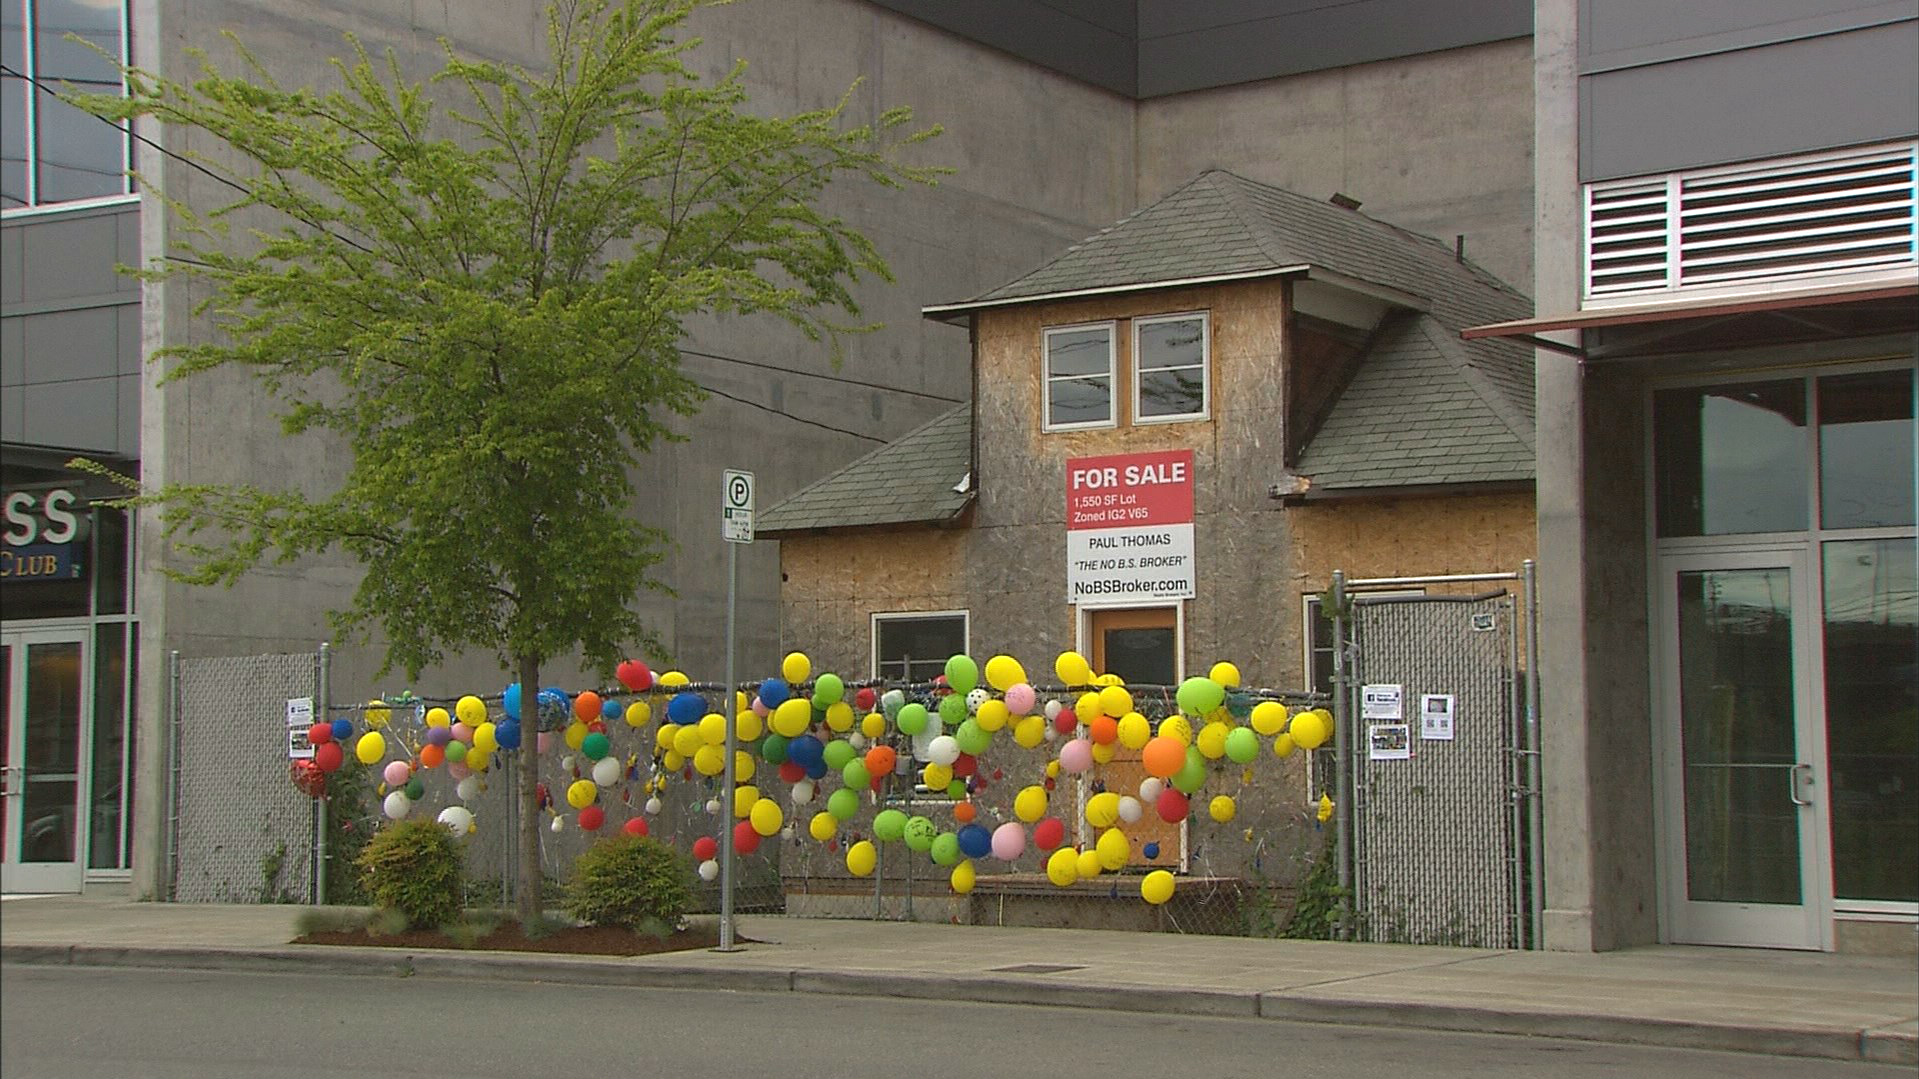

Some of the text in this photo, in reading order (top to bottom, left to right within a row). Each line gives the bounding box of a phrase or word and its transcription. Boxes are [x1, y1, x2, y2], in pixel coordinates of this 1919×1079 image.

[1073, 462, 1185, 490] FOR SALE
[735, 483, 745, 500] P
[1074, 494, 1136, 508] 1,550 SF Lot
[1074, 507, 1148, 523] Zoned IG2 V65
[1089, 534, 1171, 549] PAUL THOMAS
[1099, 559, 1116, 570] NO
[1118, 558, 1137, 570] B.S.
[1075, 579, 1188, 595] NoBSBroker.com
